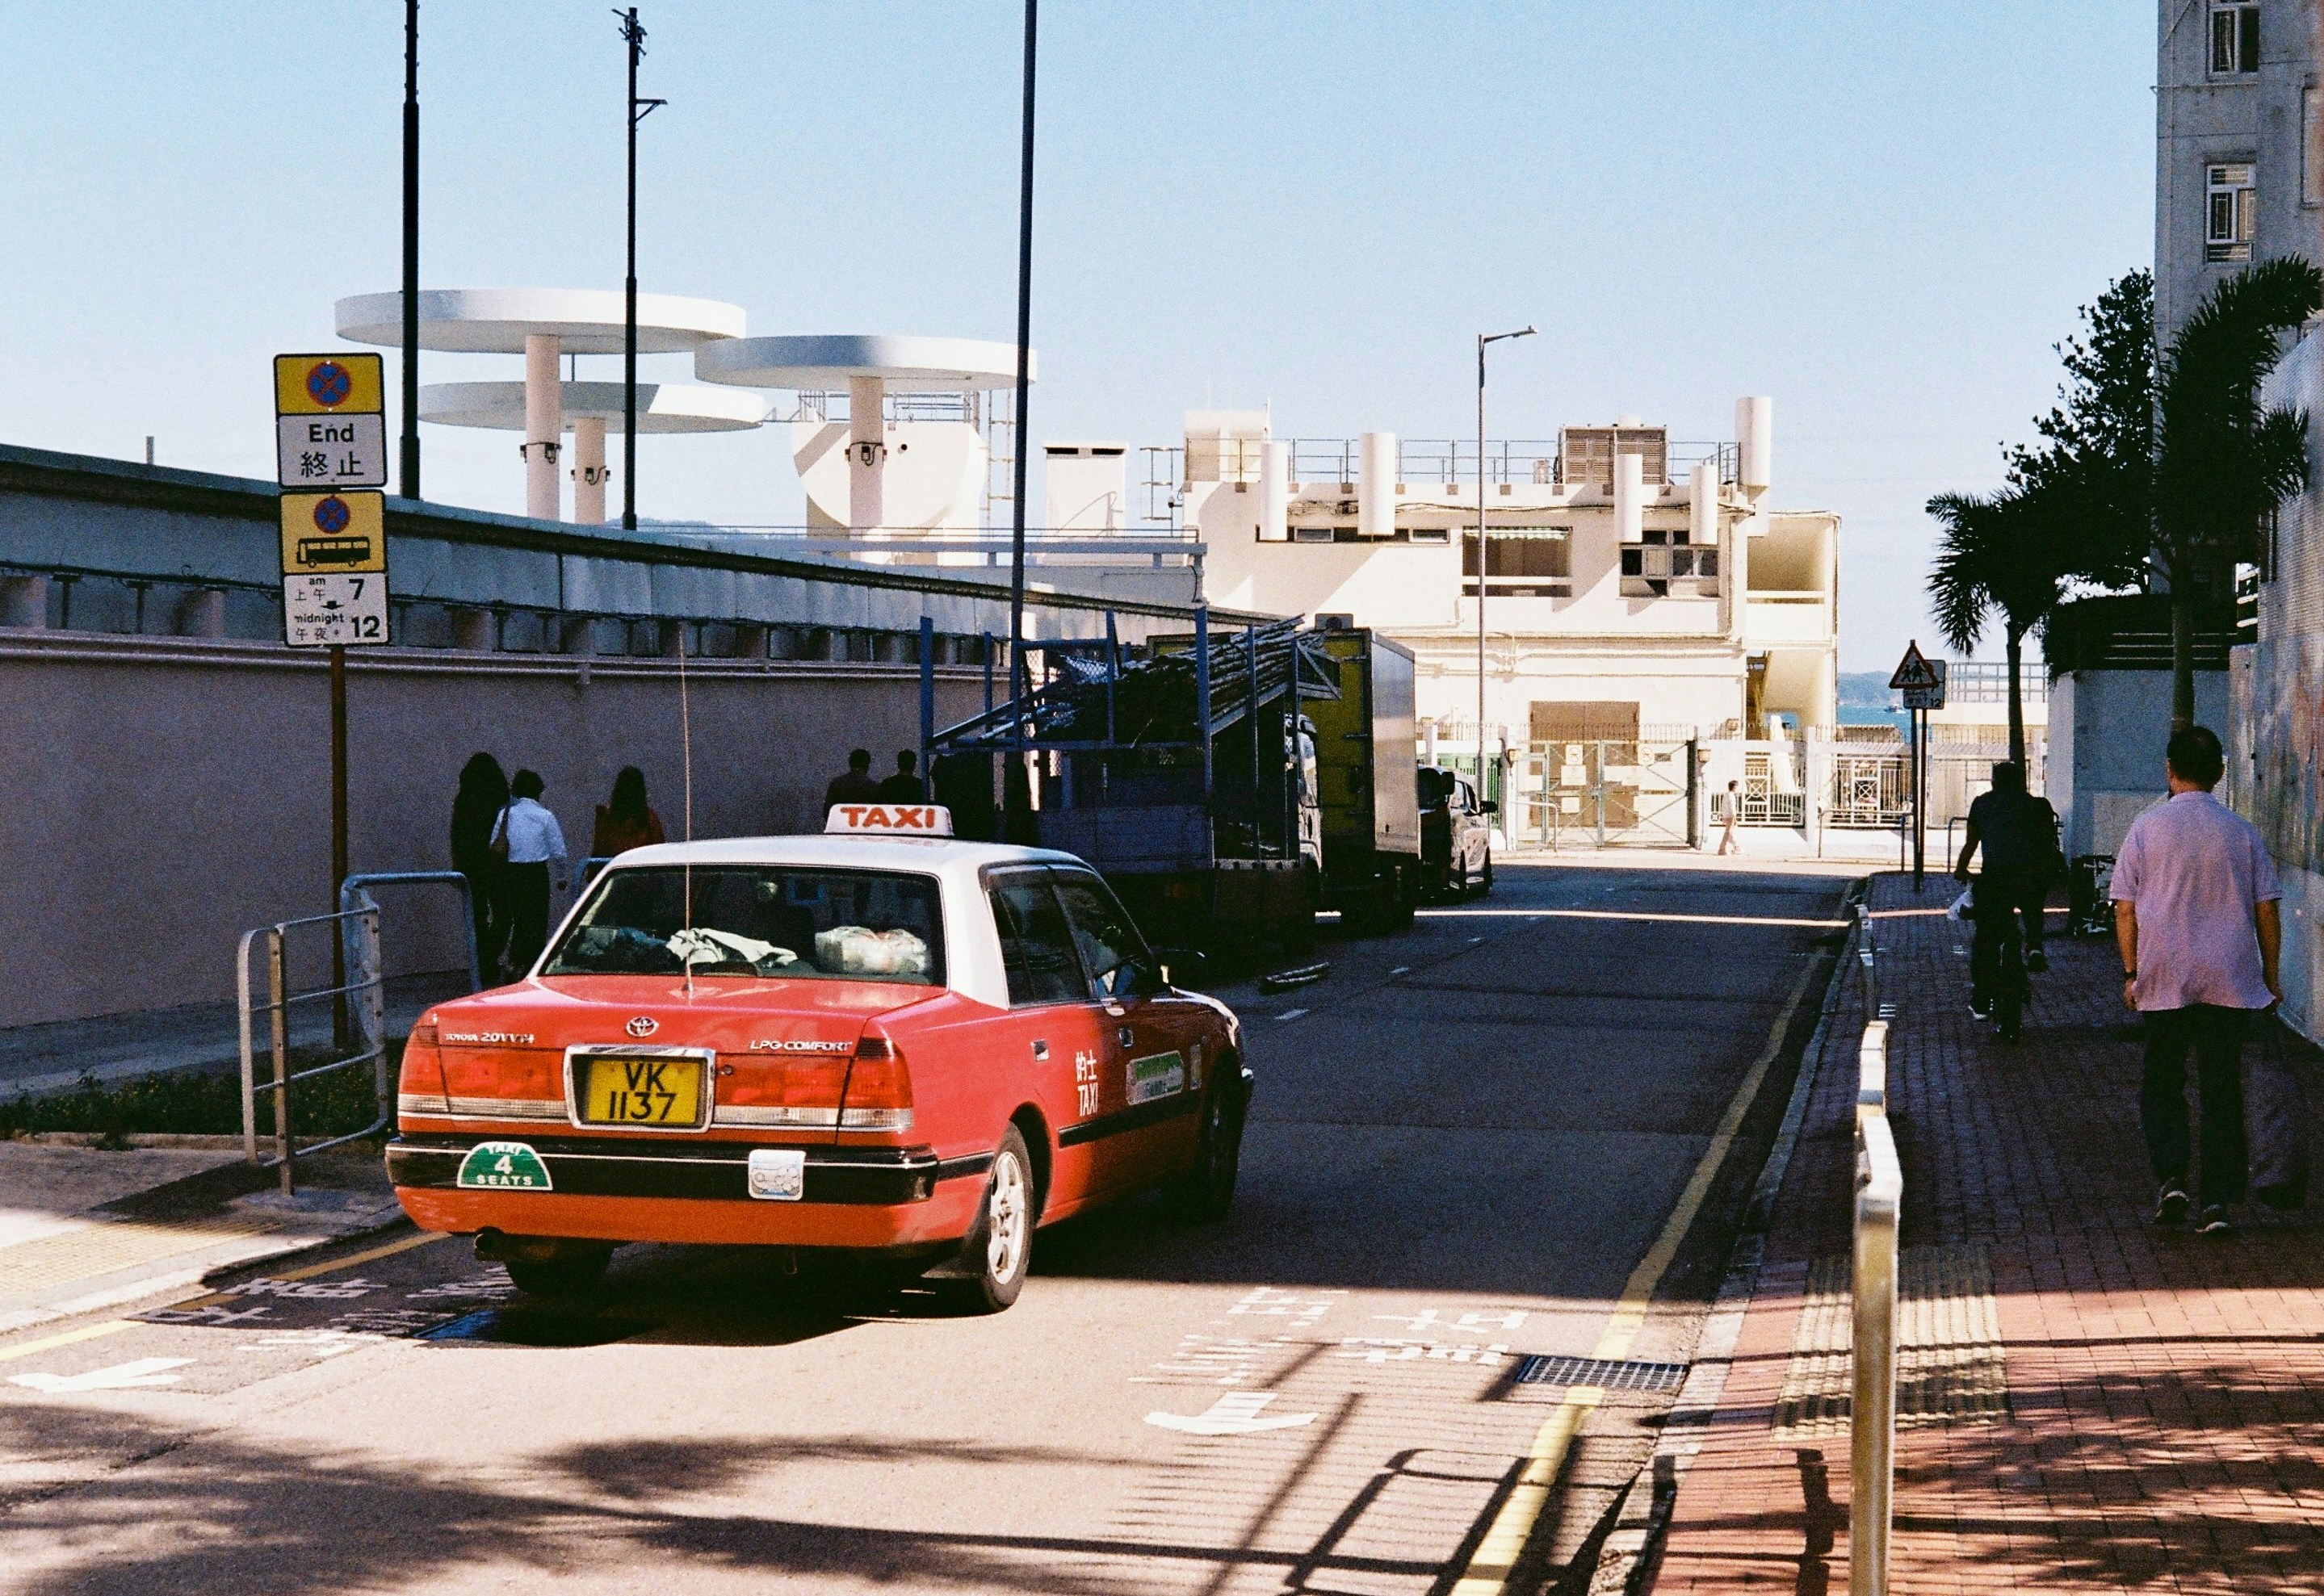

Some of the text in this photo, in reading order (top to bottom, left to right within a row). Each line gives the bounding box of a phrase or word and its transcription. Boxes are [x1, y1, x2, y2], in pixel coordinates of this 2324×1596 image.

[309, 423, 354, 442] End
[301, 451, 365, 478] 終止
[308, 577, 326, 585] am
[349, 578, 365, 600] 7
[295, 588, 326, 601] 上午
[294, 613, 345, 625] midnight
[351, 615, 380, 638] 12
[296, 627, 329, 641] 午夜
[840, 806, 936, 829] TAXI
[1076, 1049, 1097, 1082] 的士
[624, 1063, 668, 1091] VK
[609, 1091, 677, 1121] 1137
[1077, 1083, 1098, 1117] TAXI
[494, 1154, 514, 1175] 4
[476, 1174, 533, 1187] SEATS
